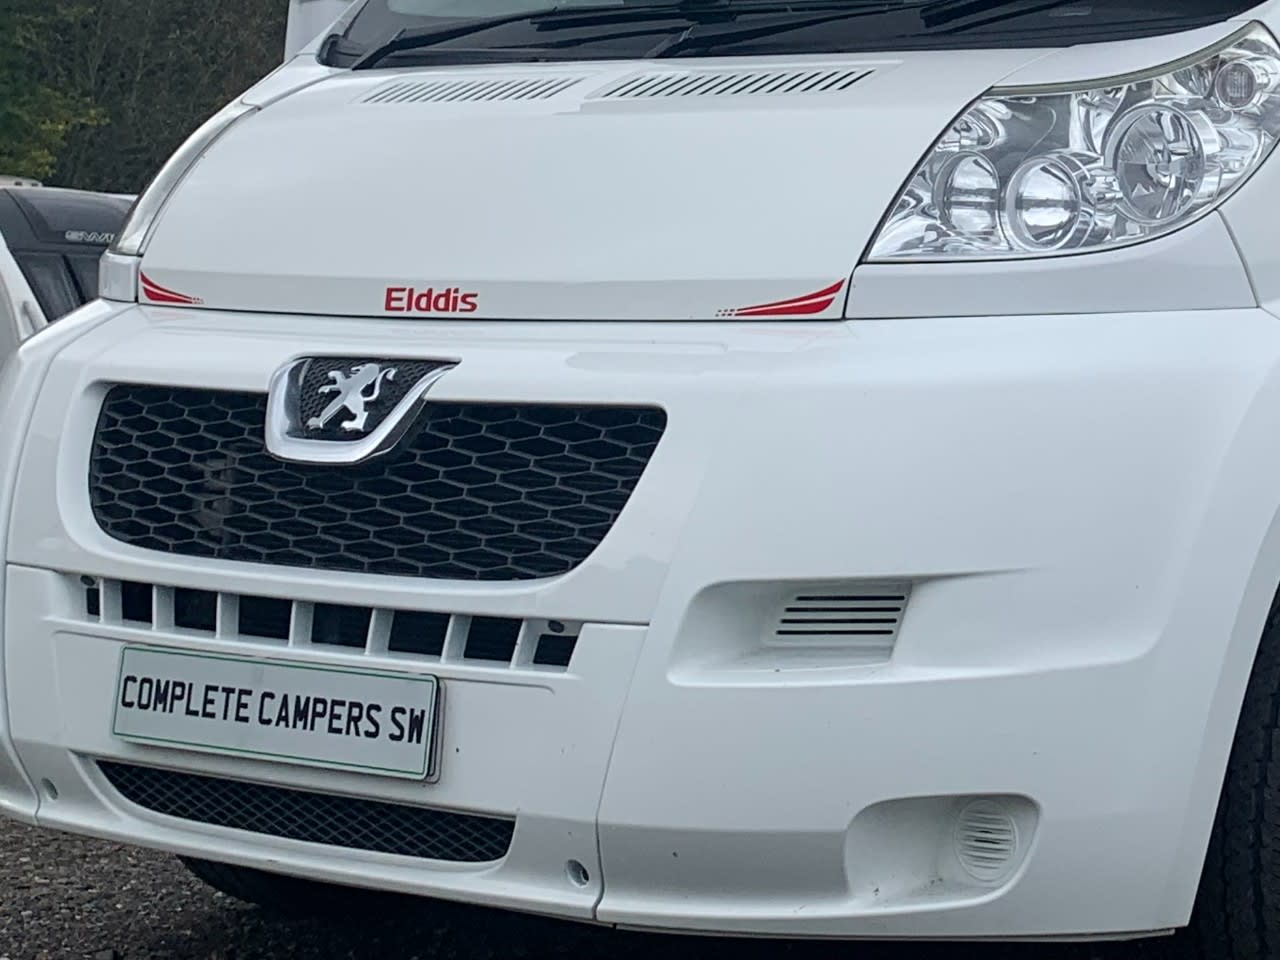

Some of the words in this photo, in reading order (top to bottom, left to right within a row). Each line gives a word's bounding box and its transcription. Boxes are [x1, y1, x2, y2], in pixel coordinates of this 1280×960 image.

[384, 287, 478, 313] Elddis
[121, 675, 253, 723] COMPLETE
[258, 691, 382, 739] CAMPERS
[389, 706, 426, 744] SW
